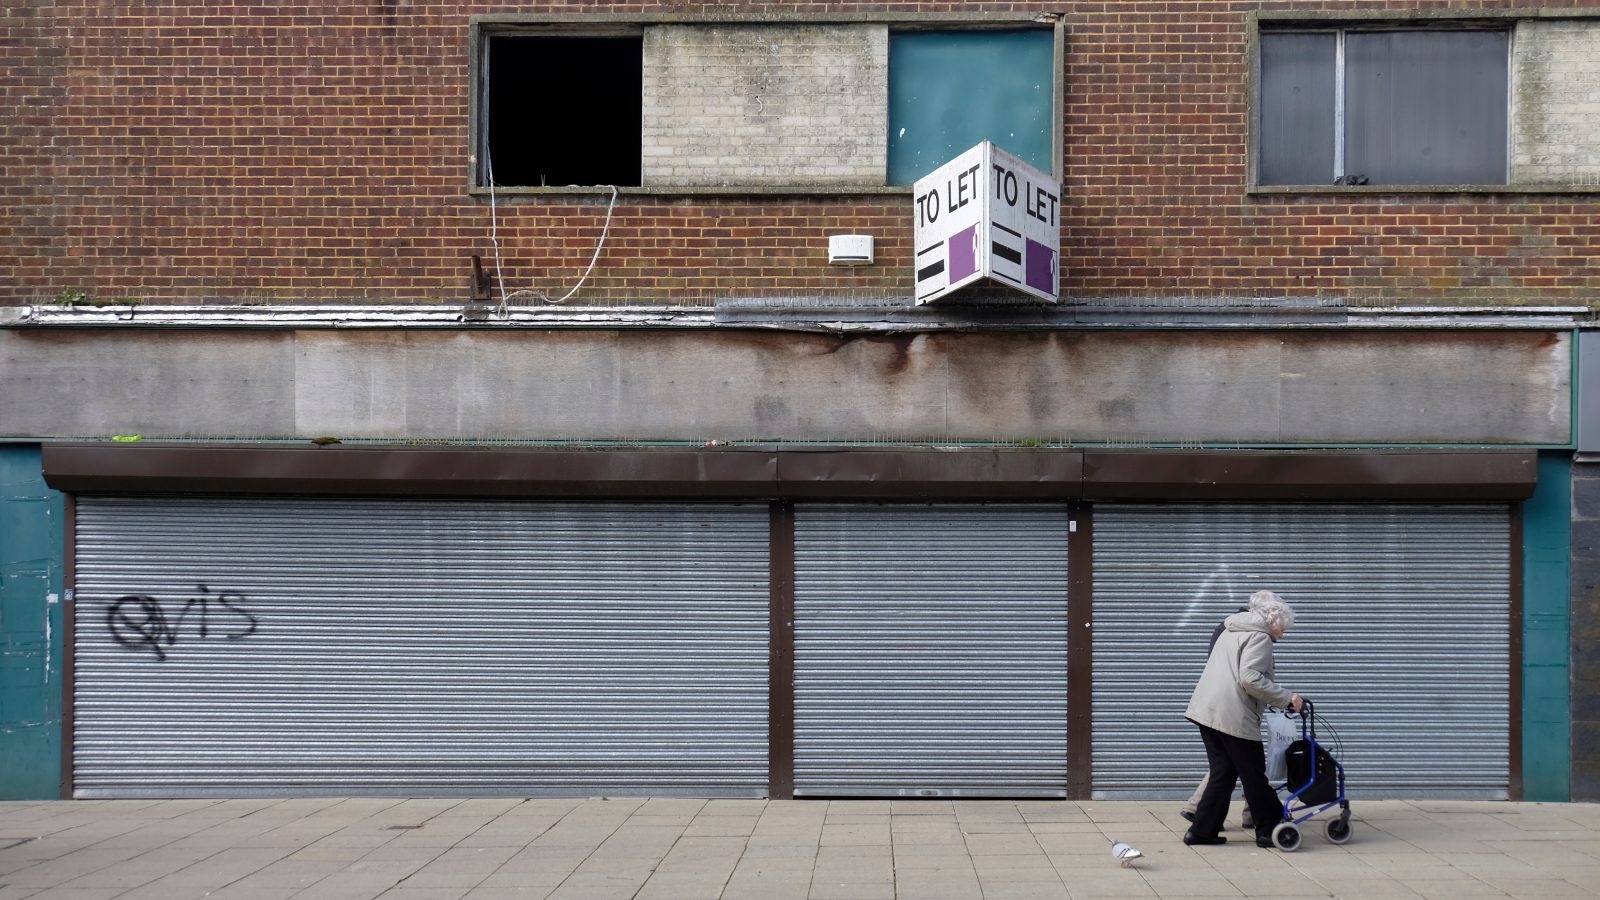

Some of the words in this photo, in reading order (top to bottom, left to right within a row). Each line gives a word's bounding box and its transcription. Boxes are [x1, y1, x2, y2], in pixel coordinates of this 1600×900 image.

[917, 189, 939, 227] TO
[948, 164, 980, 213] LET
[993, 163, 1018, 207] TO
[1027, 181, 1058, 226] LET
